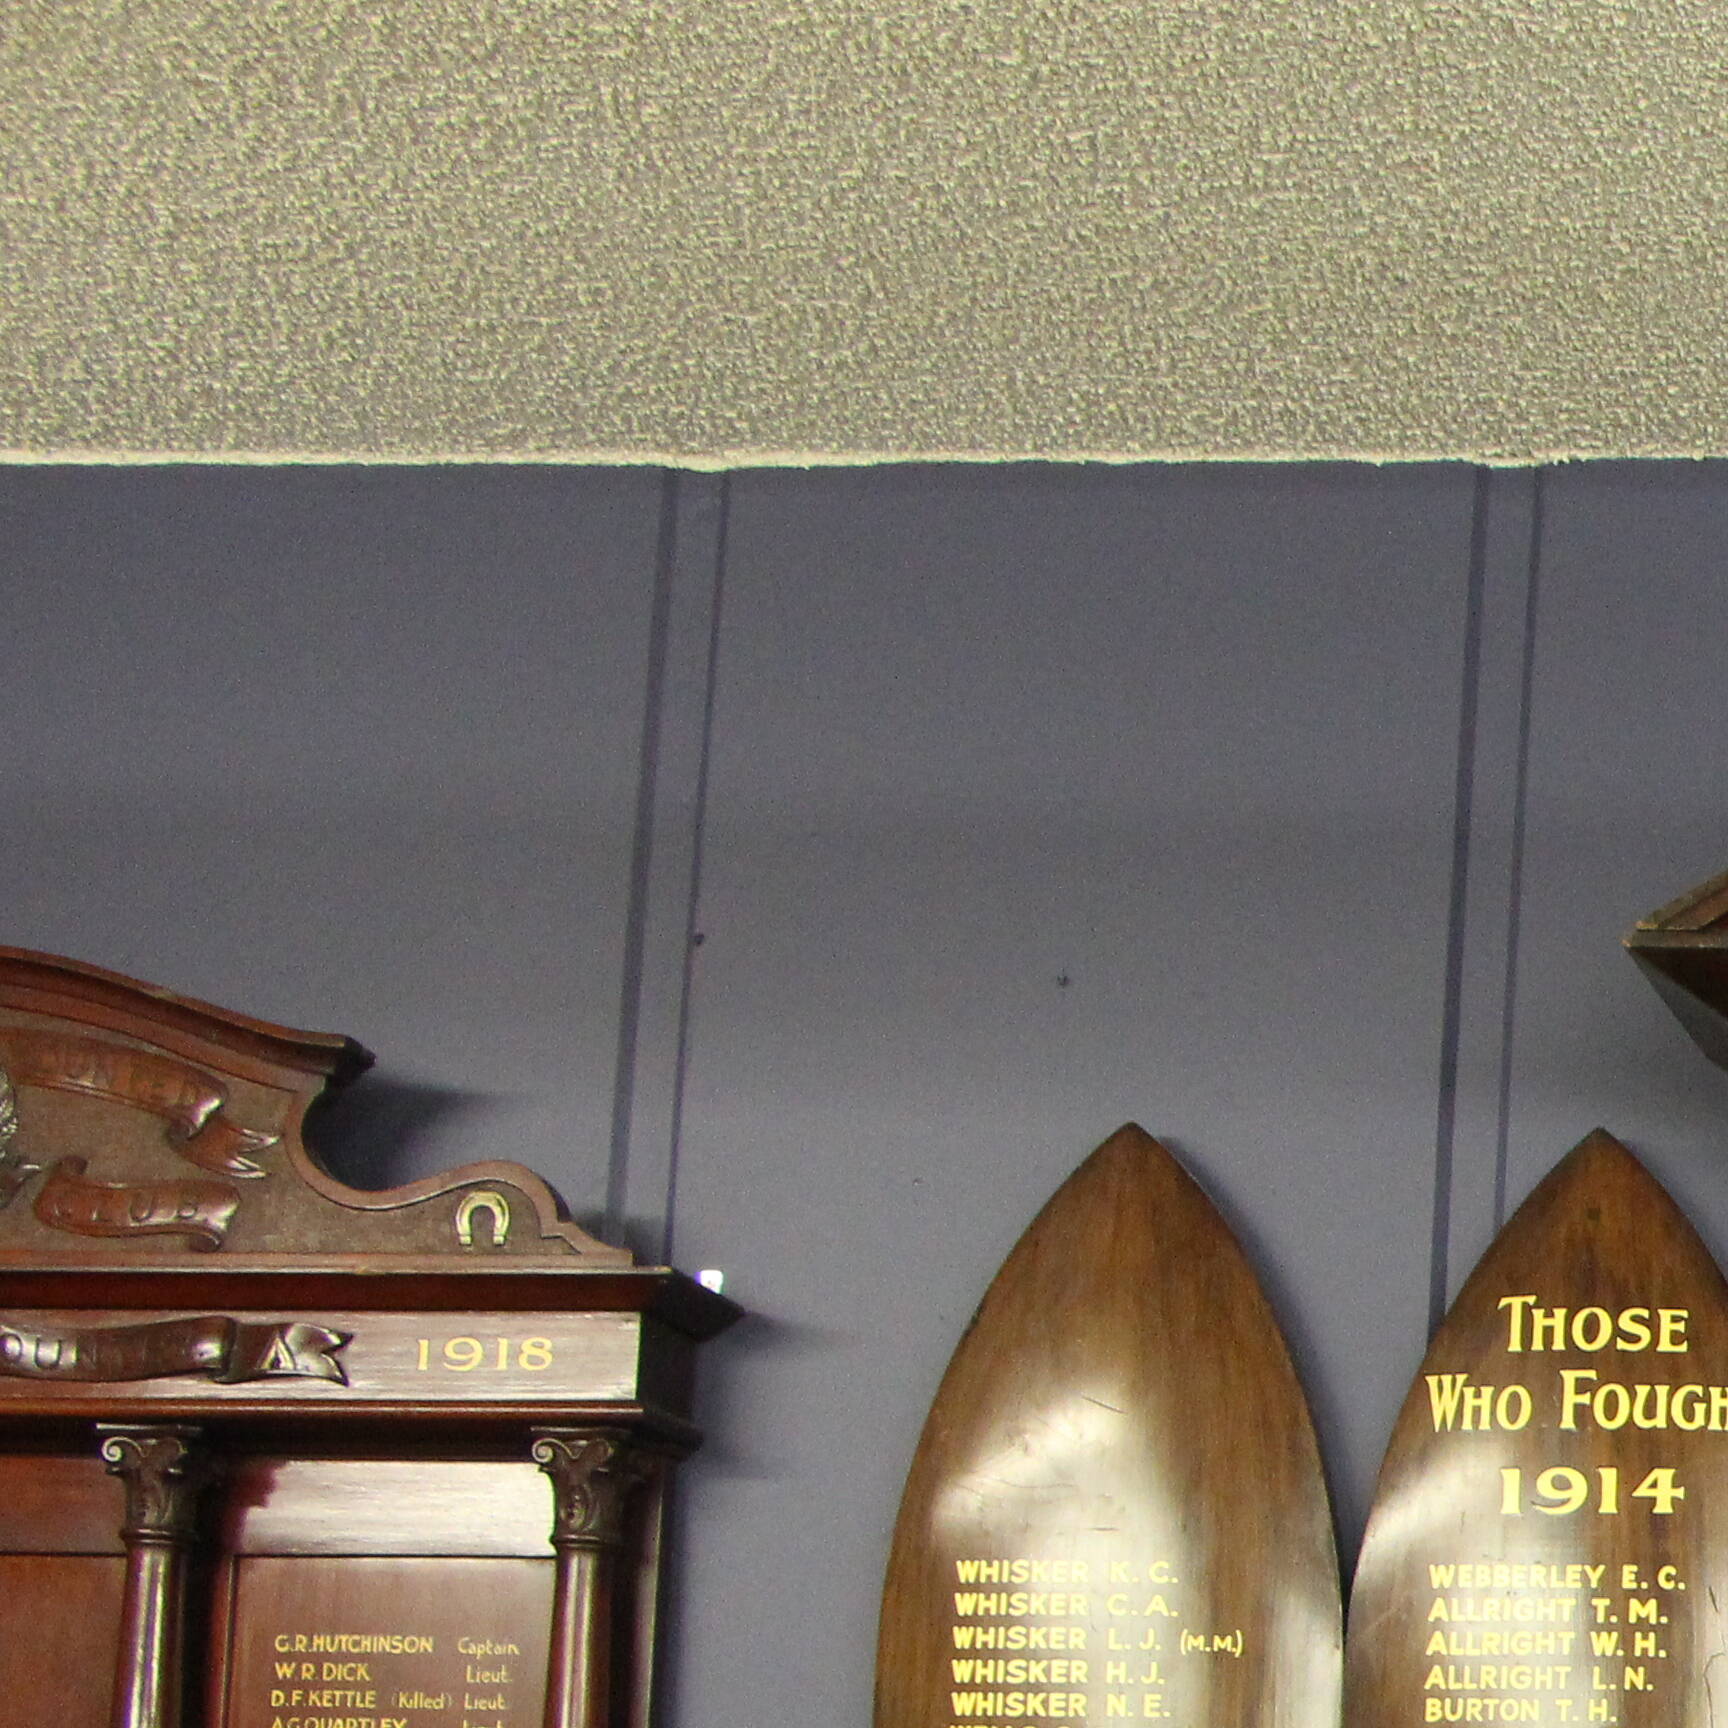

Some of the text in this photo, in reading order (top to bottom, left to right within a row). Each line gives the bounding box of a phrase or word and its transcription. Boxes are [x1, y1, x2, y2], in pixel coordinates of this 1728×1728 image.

[1499, 1296, 1689, 1352] THOSE
[419, 1337, 554, 1371] 1918
[1427, 1374, 1533, 1430] WHO
[1502, 1467, 1685, 1514] 1914
